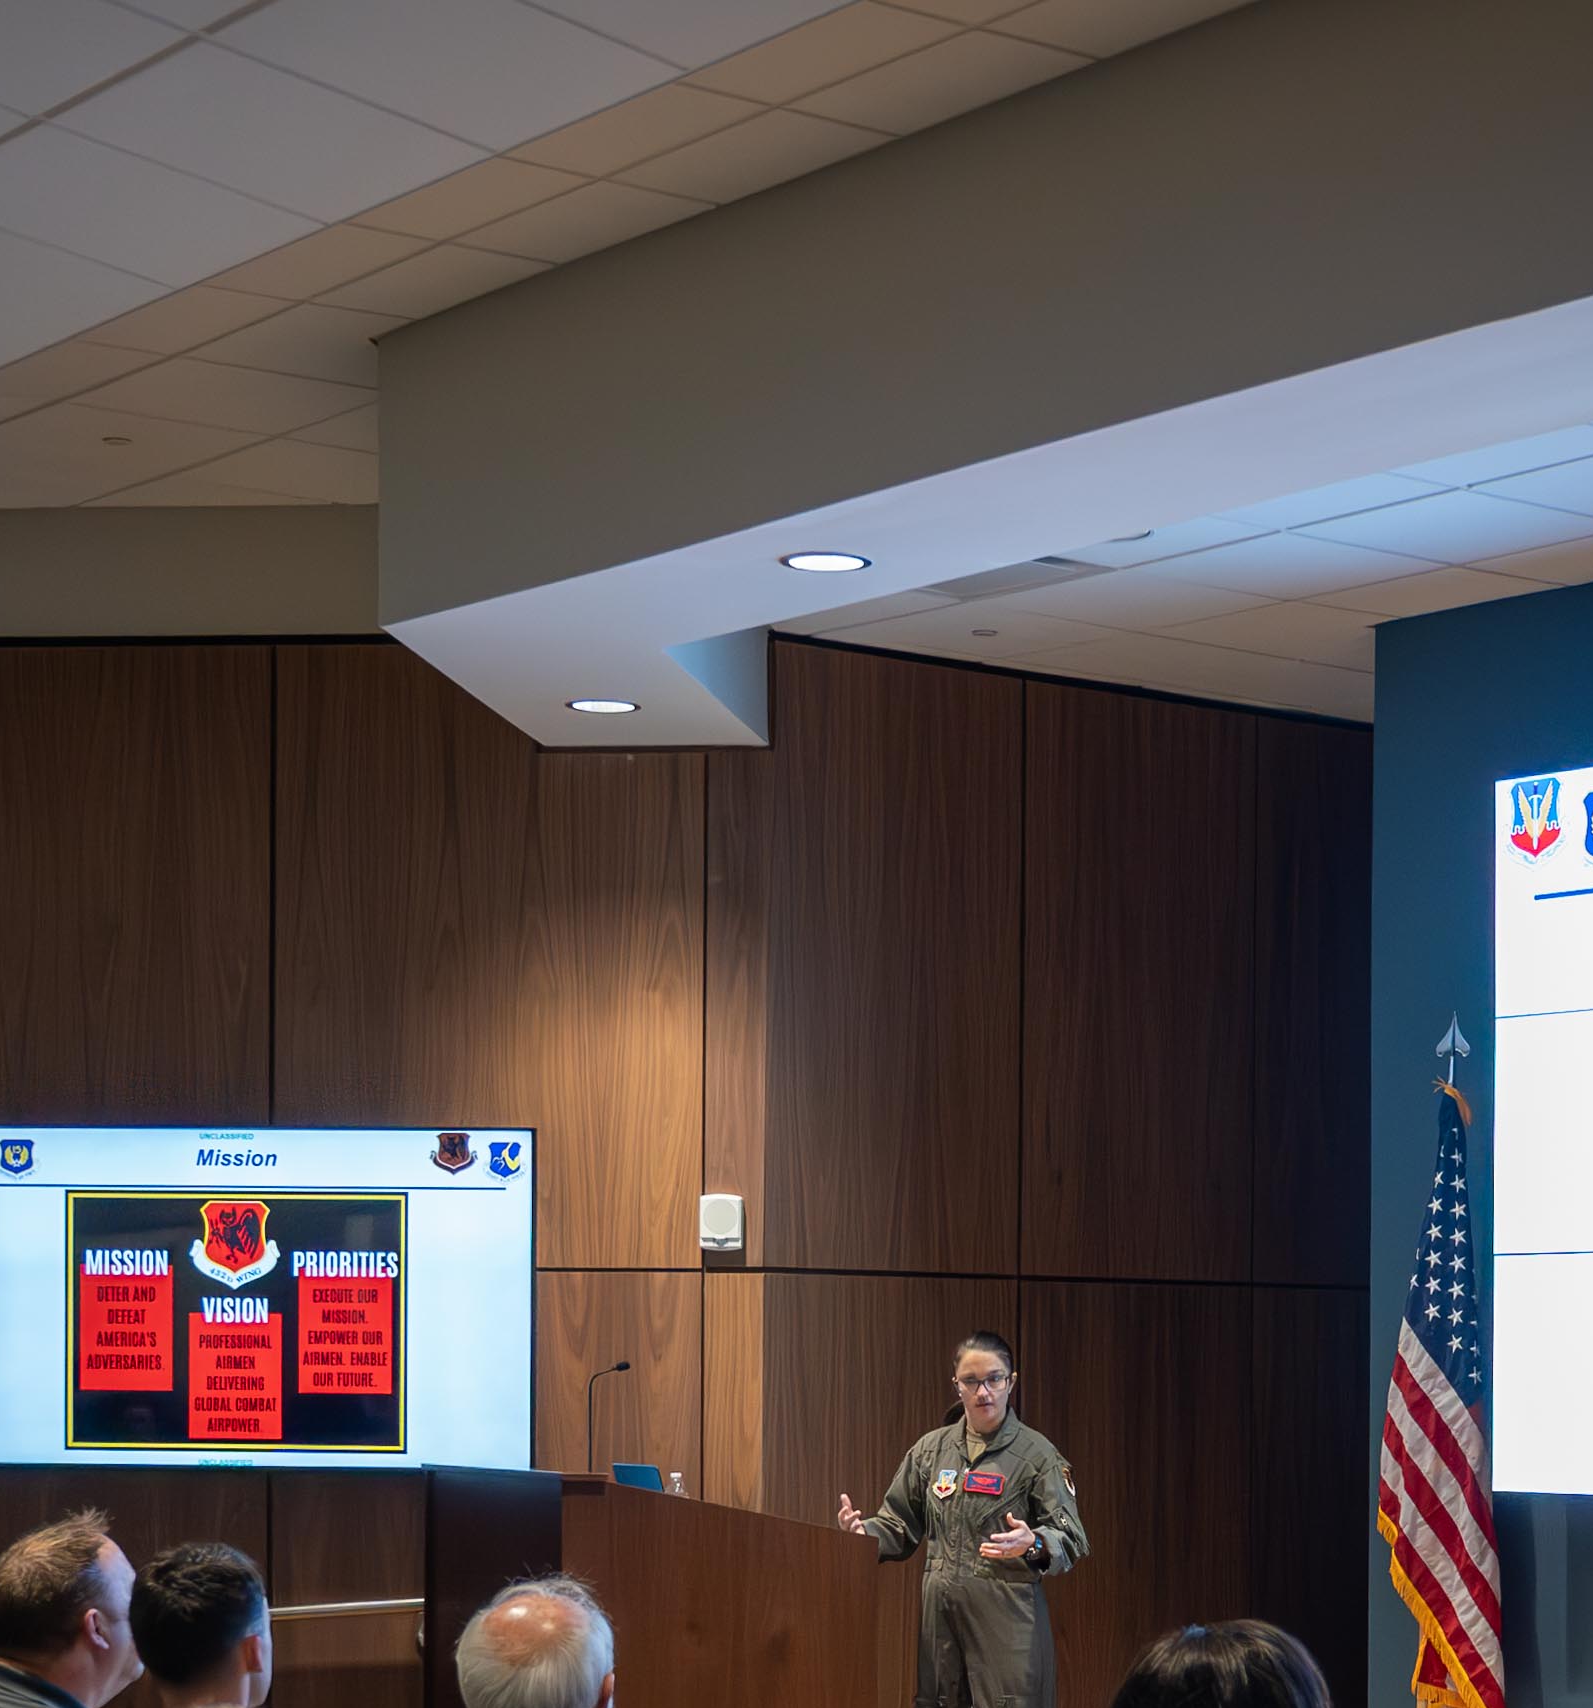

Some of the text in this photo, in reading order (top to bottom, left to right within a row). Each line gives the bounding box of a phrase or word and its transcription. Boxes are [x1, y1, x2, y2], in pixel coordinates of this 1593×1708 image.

[196, 1149, 277, 1167] Mission
[85, 1248, 169, 1276] MISSION
[292, 1251, 399, 1278] PRIORITIES
[97, 1286, 156, 1302] DETER AND
[312, 1289, 378, 1303] EXECUTE OUR
[107, 1308, 146, 1325] DEFEAT
[201, 1296, 269, 1324] VISION
[322, 1309, 369, 1324] MISSION.
[96, 1331, 157, 1347] AMERICA'S
[199, 1334, 273, 1349] PROFESSIONAL
[308, 1330, 383, 1345] EMPOWER OUR
[86, 1354, 165, 1370] ADVERSARIES.
[215, 1355, 255, 1369] AIRMEN
[303, 1351, 388, 1366] AIRMEN. ENABLE
[206, 1376, 265, 1391] DELIVERING
[313, 1372, 378, 1387] OUR FUTURE.
[194, 1396, 277, 1412] GLOBAL COMBAT
